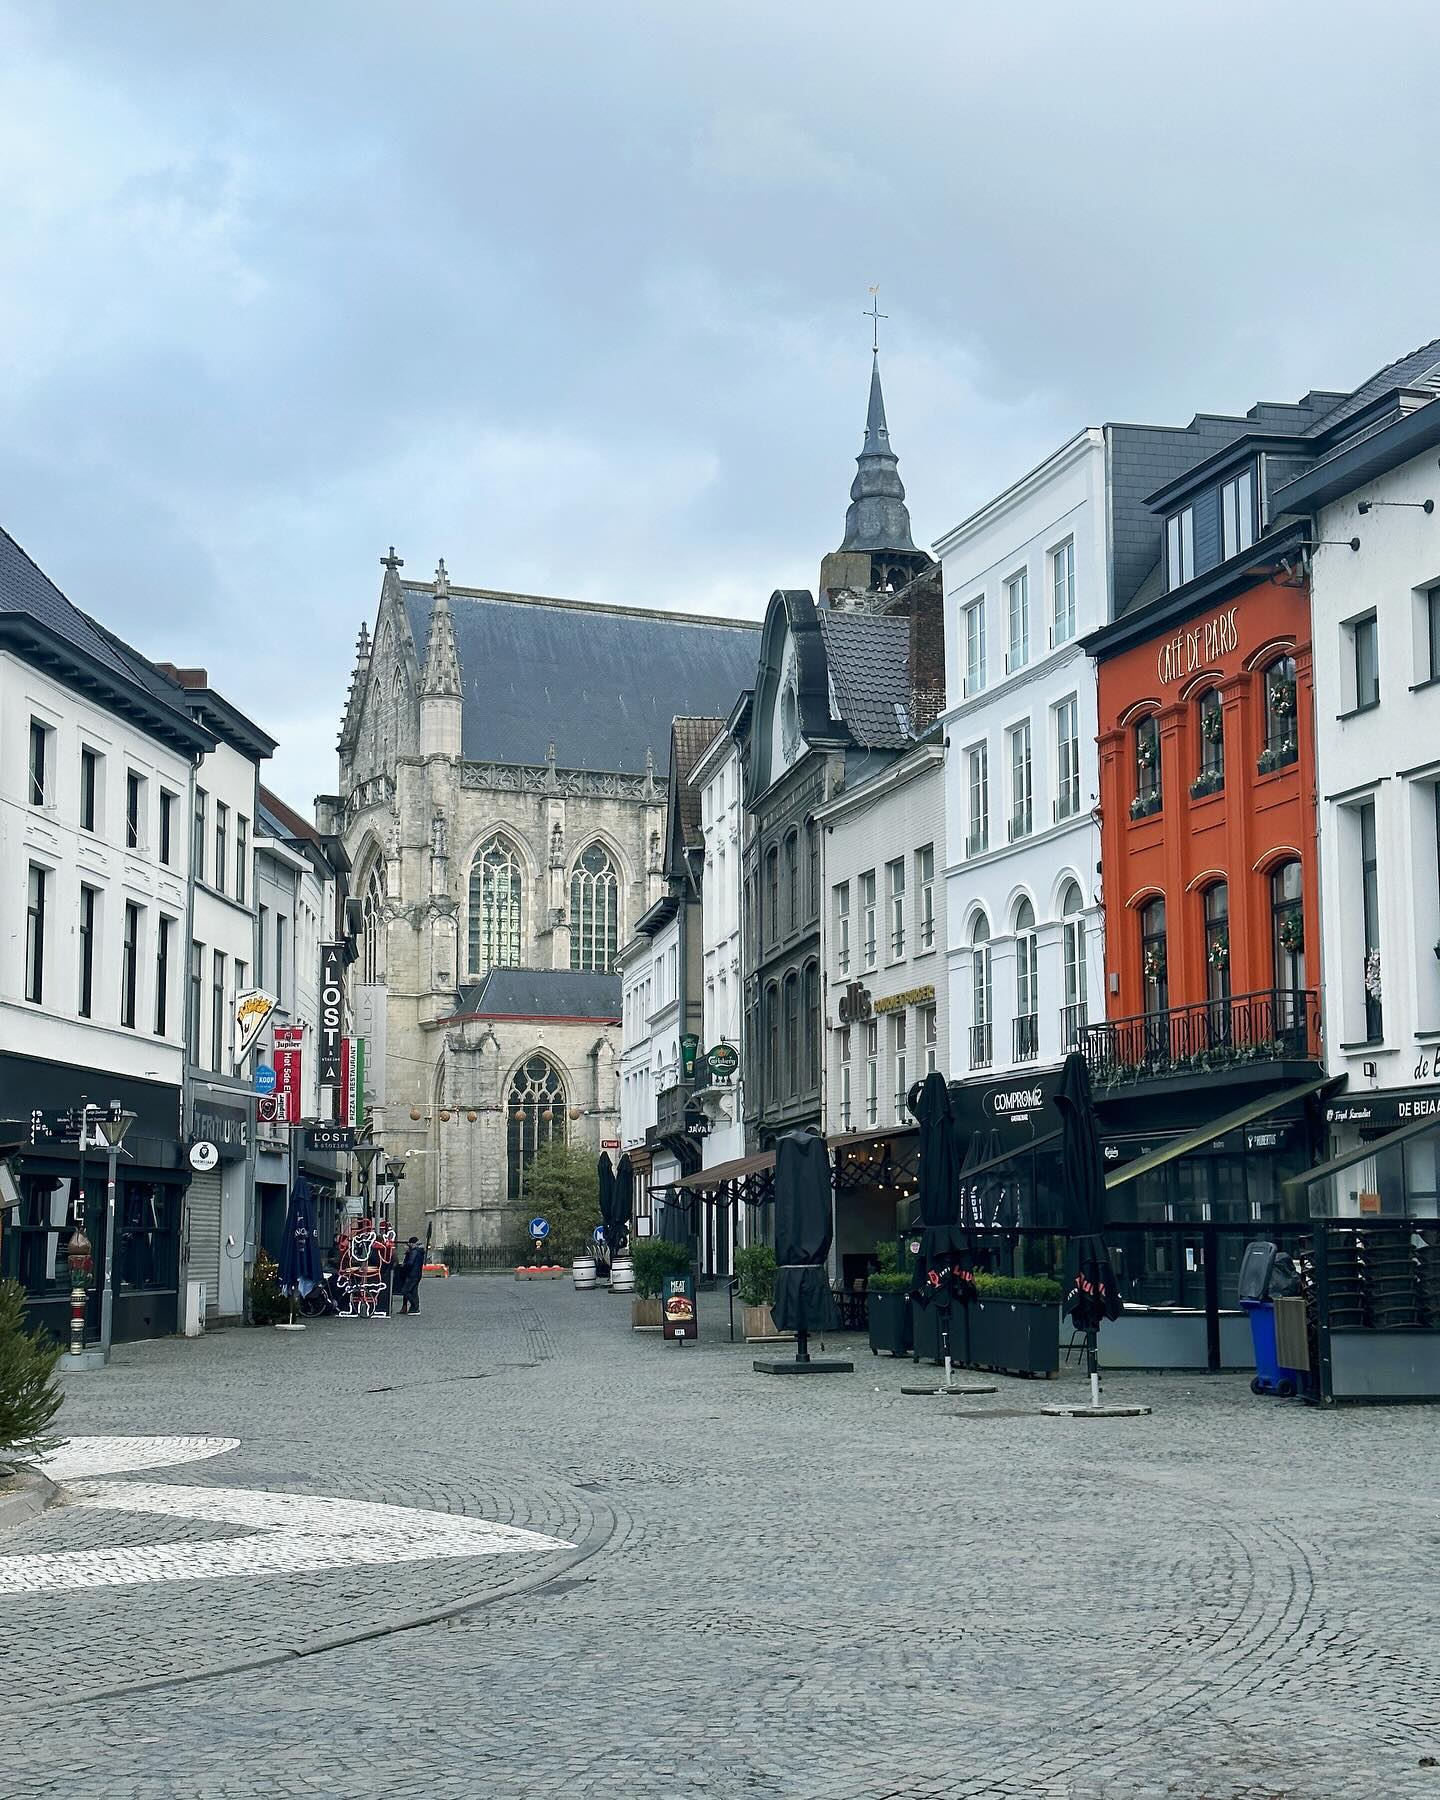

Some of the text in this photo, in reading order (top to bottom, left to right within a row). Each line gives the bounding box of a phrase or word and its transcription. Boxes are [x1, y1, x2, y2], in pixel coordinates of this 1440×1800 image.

[1158, 607, 1238, 684] CAFÉ DE PARIS
[276, 1041, 301, 1049] Jupiler
[708, 1056, 736, 1067] Carlsberg
[1398, 1102, 1412, 1117] DE
[314, 1133, 349, 1142] LOST
